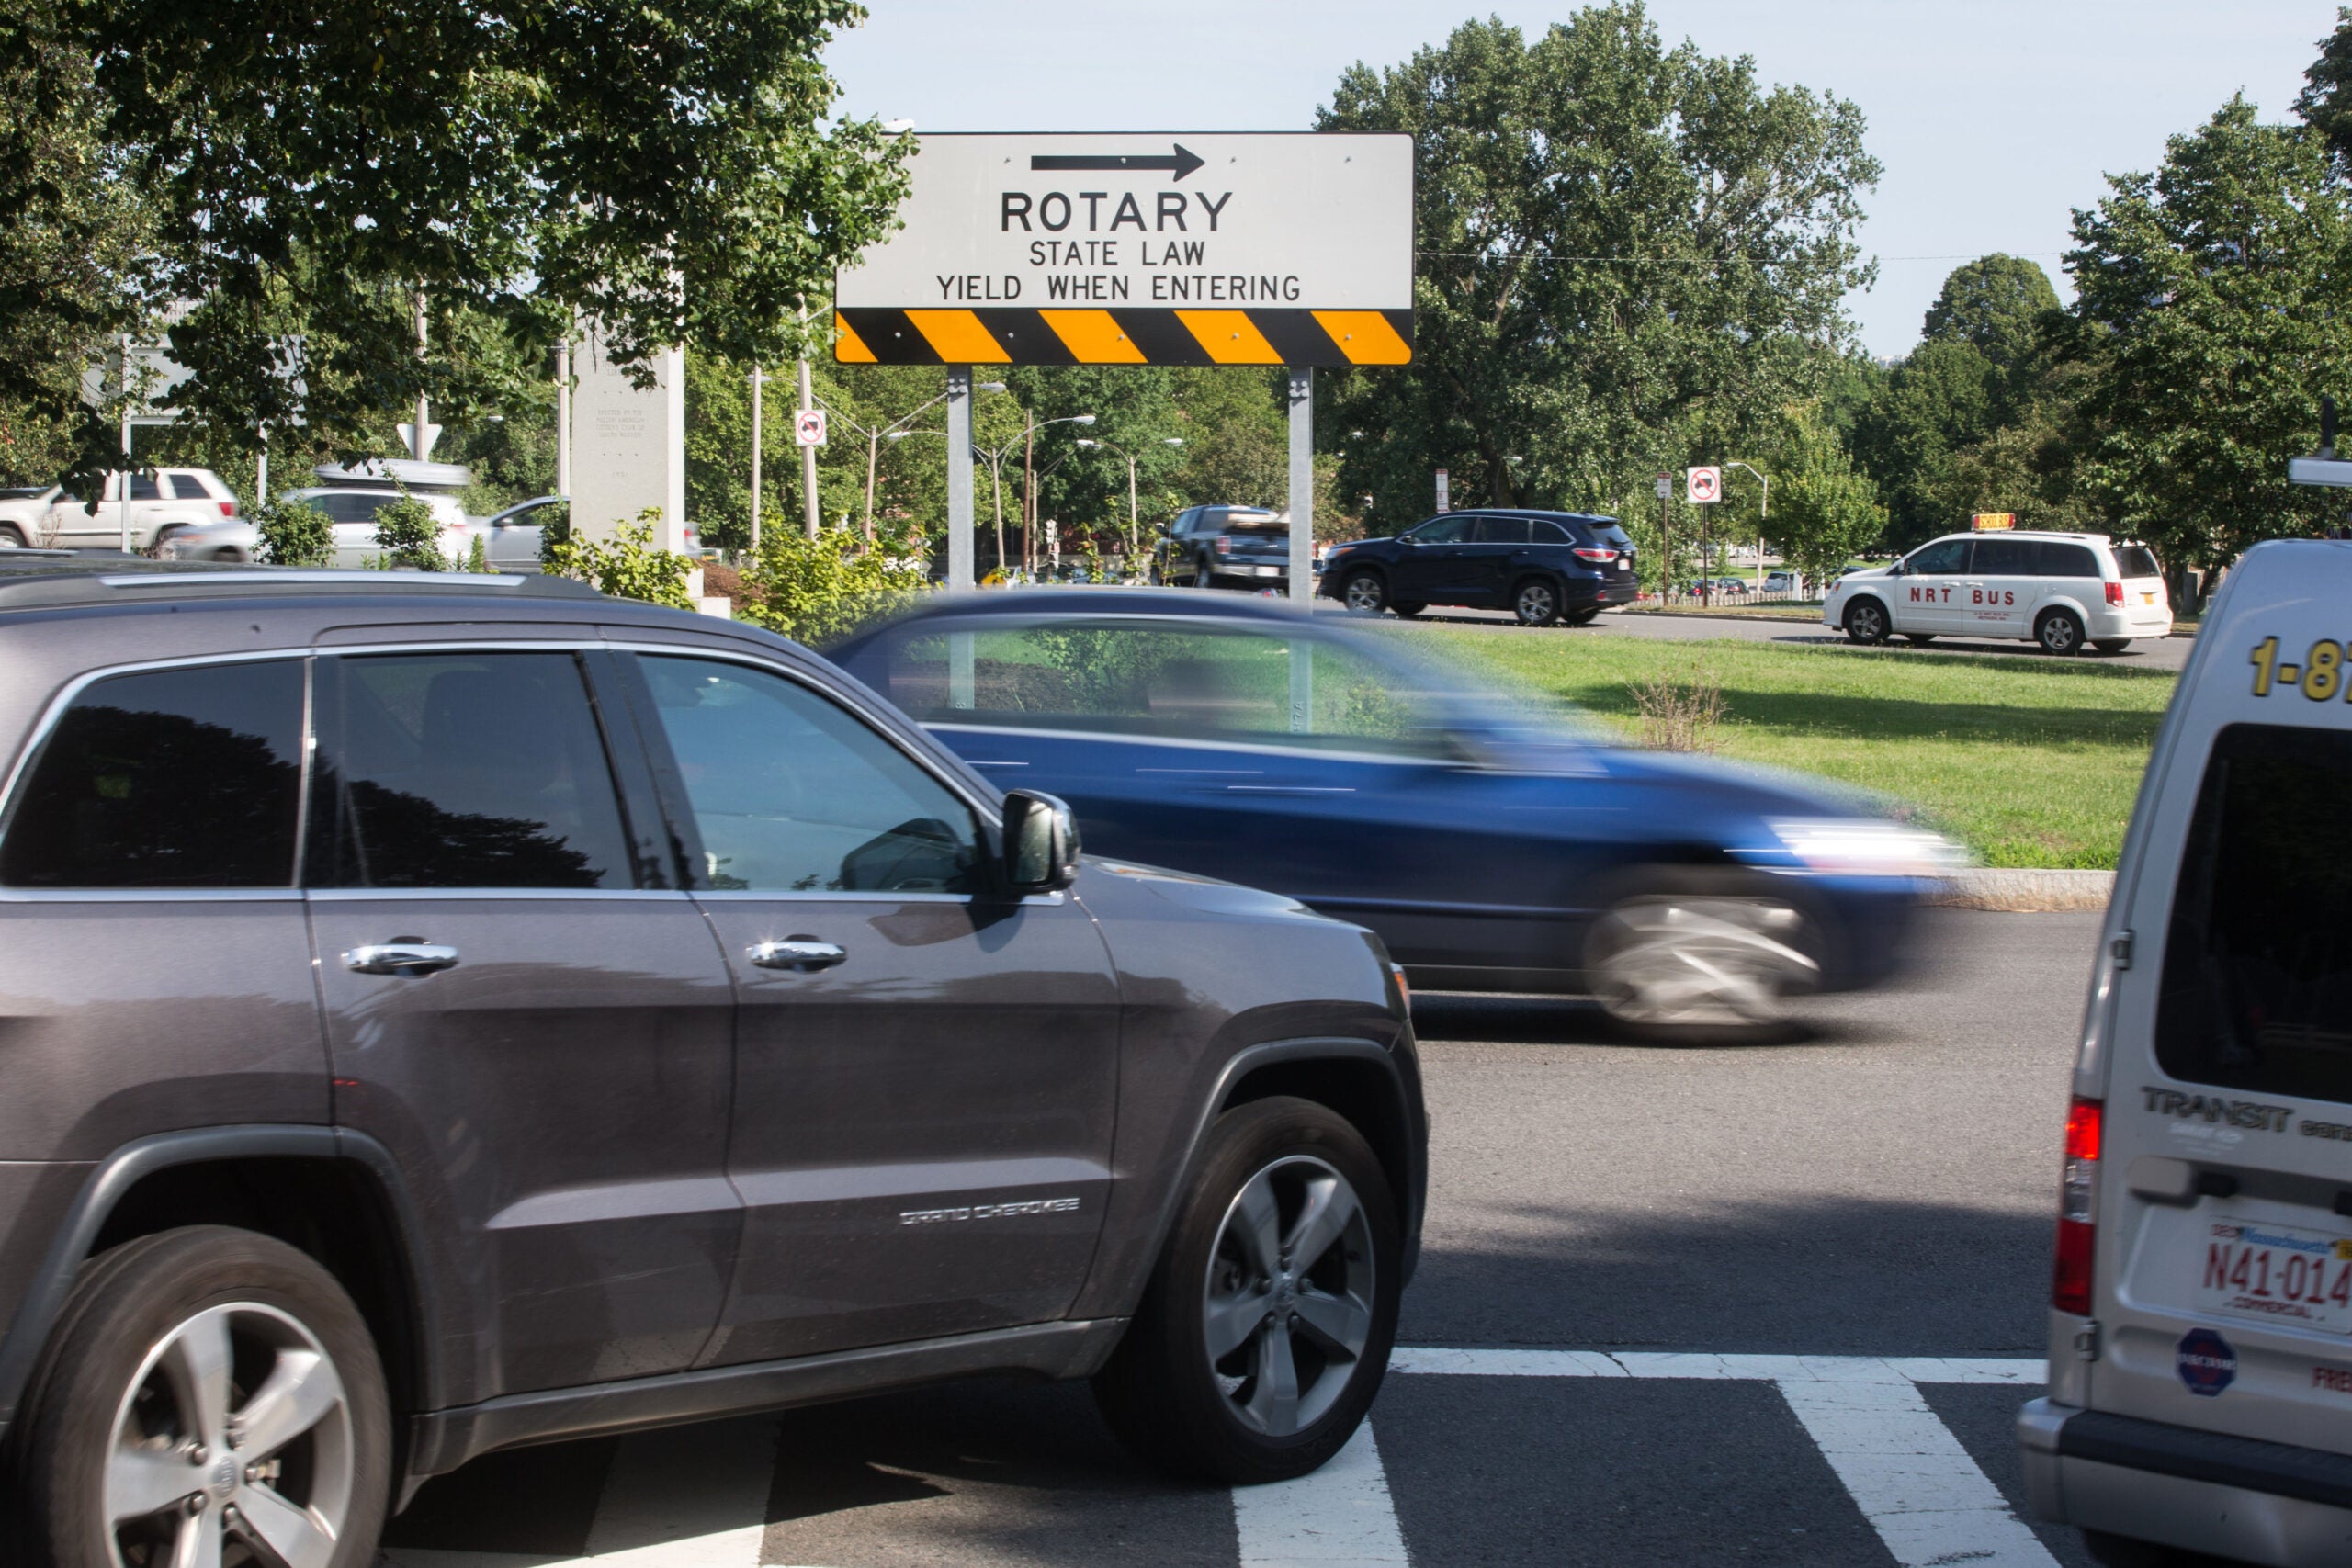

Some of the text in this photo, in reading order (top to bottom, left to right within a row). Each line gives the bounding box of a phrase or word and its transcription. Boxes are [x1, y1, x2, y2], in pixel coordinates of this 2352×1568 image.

[1001, 191, 1234, 231] ROTARY
[1029, 240, 1205, 267] STATE LAW
[935, 275, 1302, 302] YIELD WHEN ENTERING
[1980, 514, 2009, 528] SCHOOL BUS
[1910, 587, 2015, 606] NRT BUS
[2248, 635, 2352, 705] 1-8
[2140, 1085, 2295, 1133] TRANSIT
[899, 1197, 1081, 1226] GRAND CHEROKEE
[2202, 1242, 2352, 1309] N41-014
